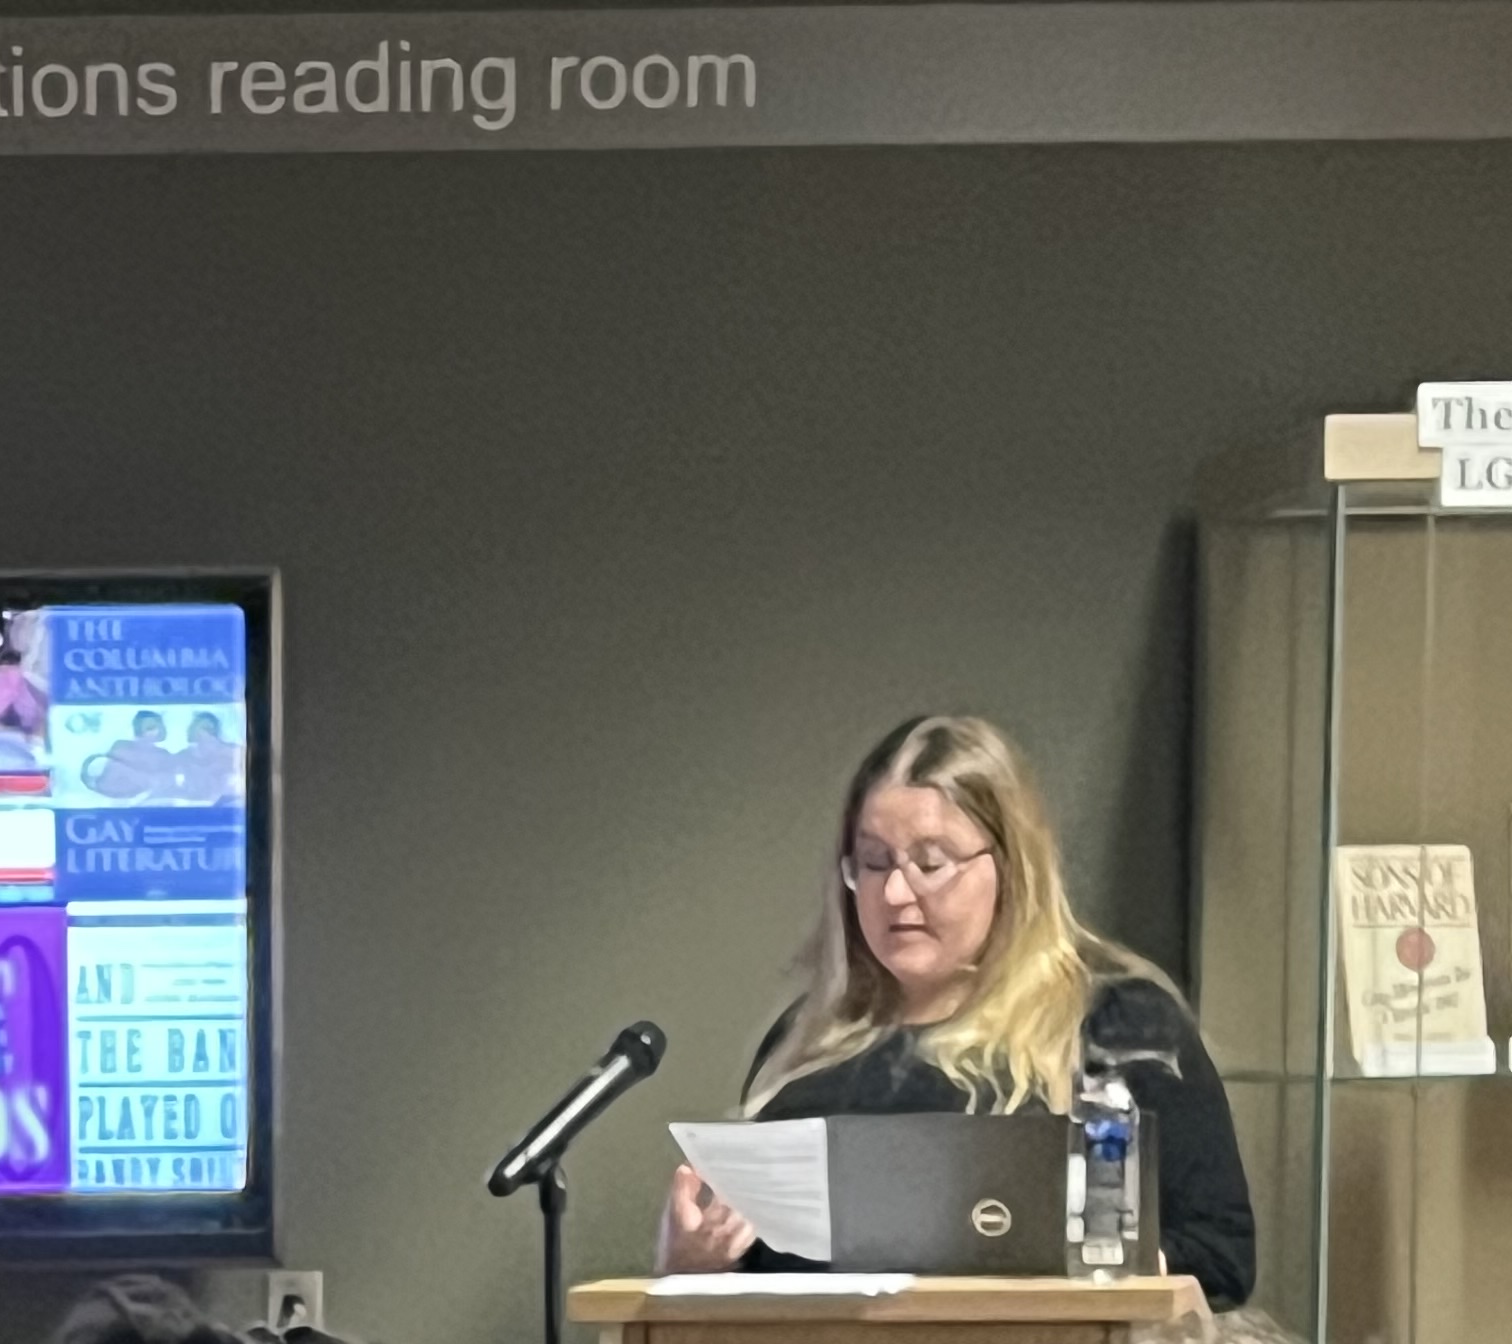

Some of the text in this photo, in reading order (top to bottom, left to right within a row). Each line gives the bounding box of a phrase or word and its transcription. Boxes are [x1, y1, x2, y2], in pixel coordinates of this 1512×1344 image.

[209, 39, 517, 131] reading
[550, 53, 757, 111] room
[65, 813, 140, 845] GAY
[76, 963, 136, 1005] AND
[76, 1028, 143, 1075] THE
[78, 1093, 201, 1141] PLAYED
